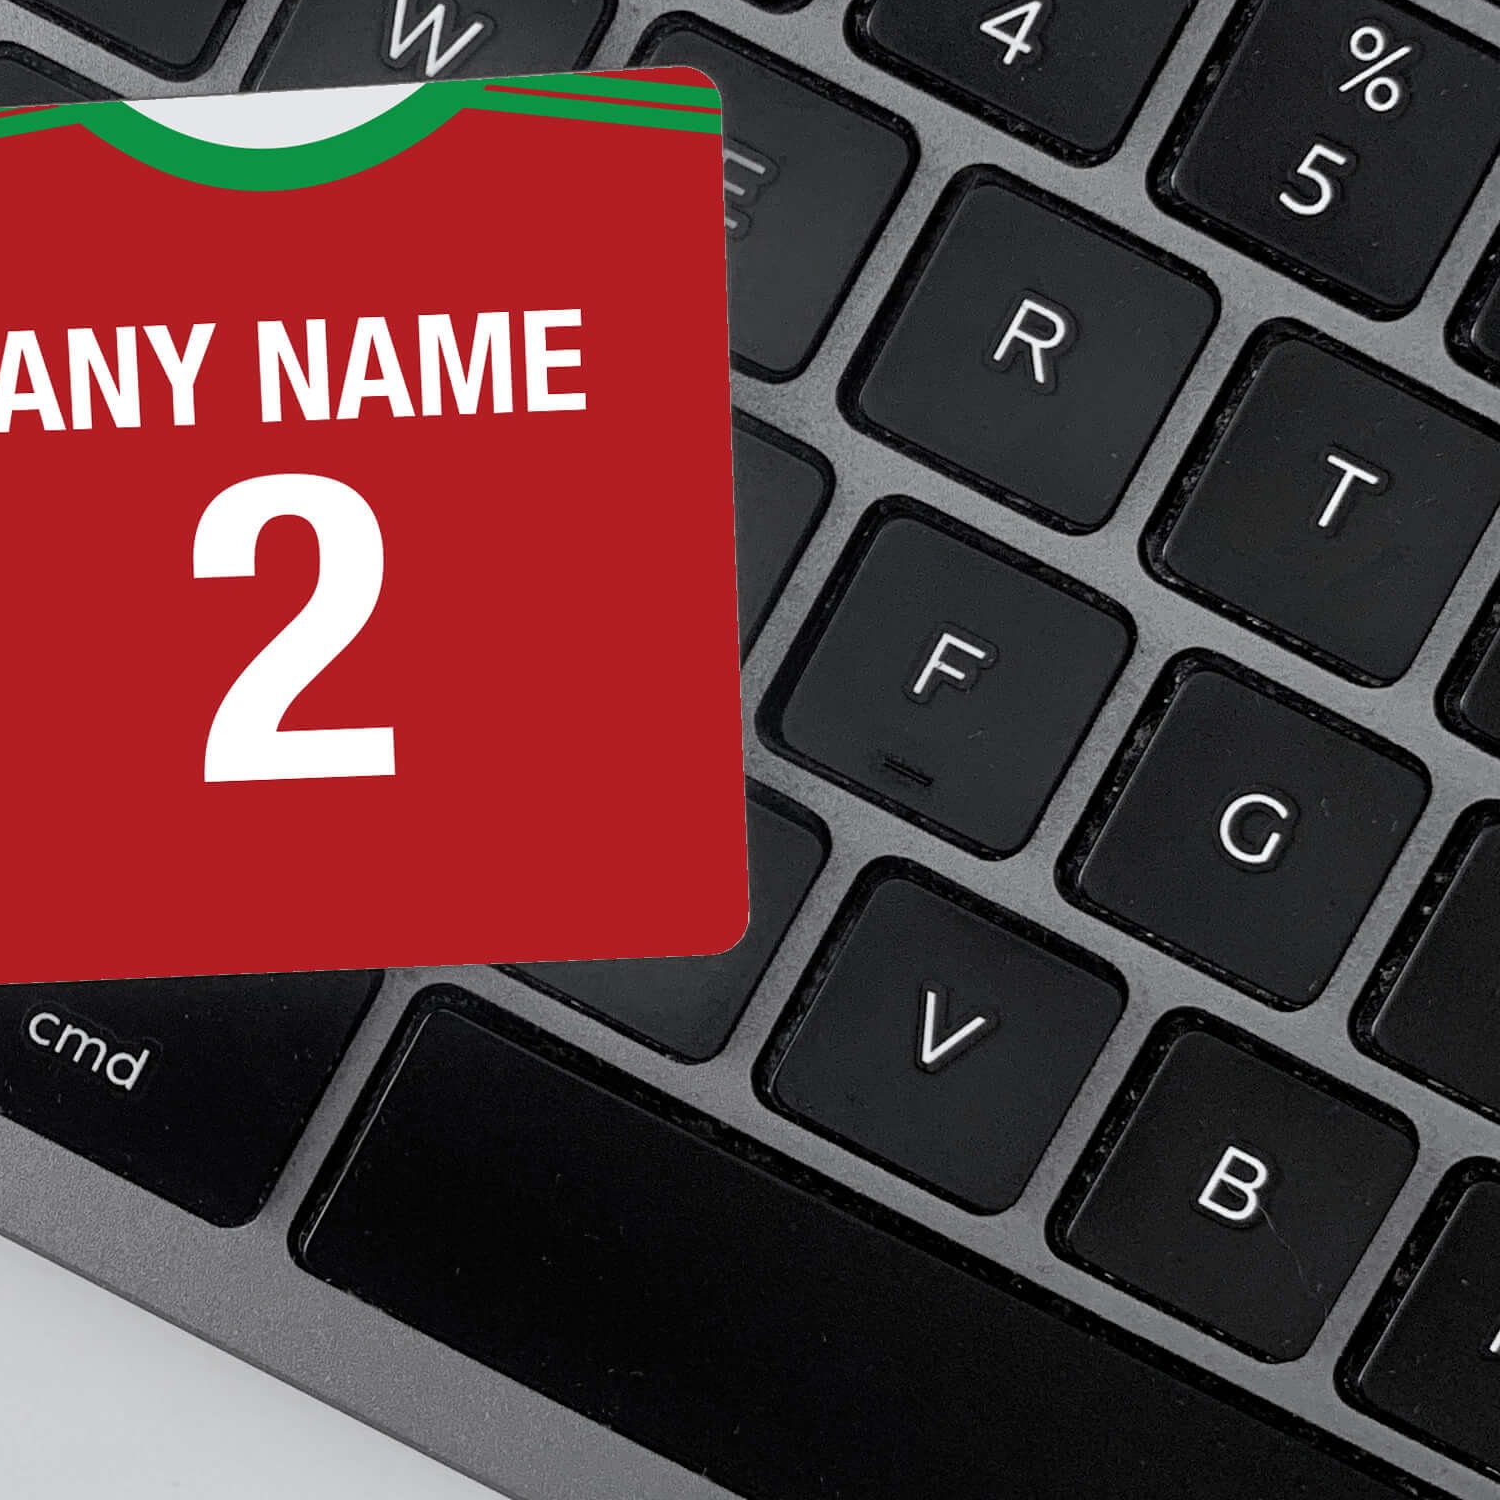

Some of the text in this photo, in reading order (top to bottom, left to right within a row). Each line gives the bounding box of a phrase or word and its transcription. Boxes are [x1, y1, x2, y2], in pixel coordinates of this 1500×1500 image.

[979, 0, 1043, 65] 4
[1337, 26, 1412, 113] %
[1279, 144, 1348, 216] 5
[258, 309, 586, 422] NAME
[993, 298, 1066, 384] R
[1317, 454, 1380, 528] T
[193, 474, 395, 782] 2
[912, 632, 986, 694] F
[1219, 793, 1289, 864] G
[27, 1011, 150, 1091] cmd
[921, 990, 986, 1064] V
[1197, 1145, 1268, 1222] B
